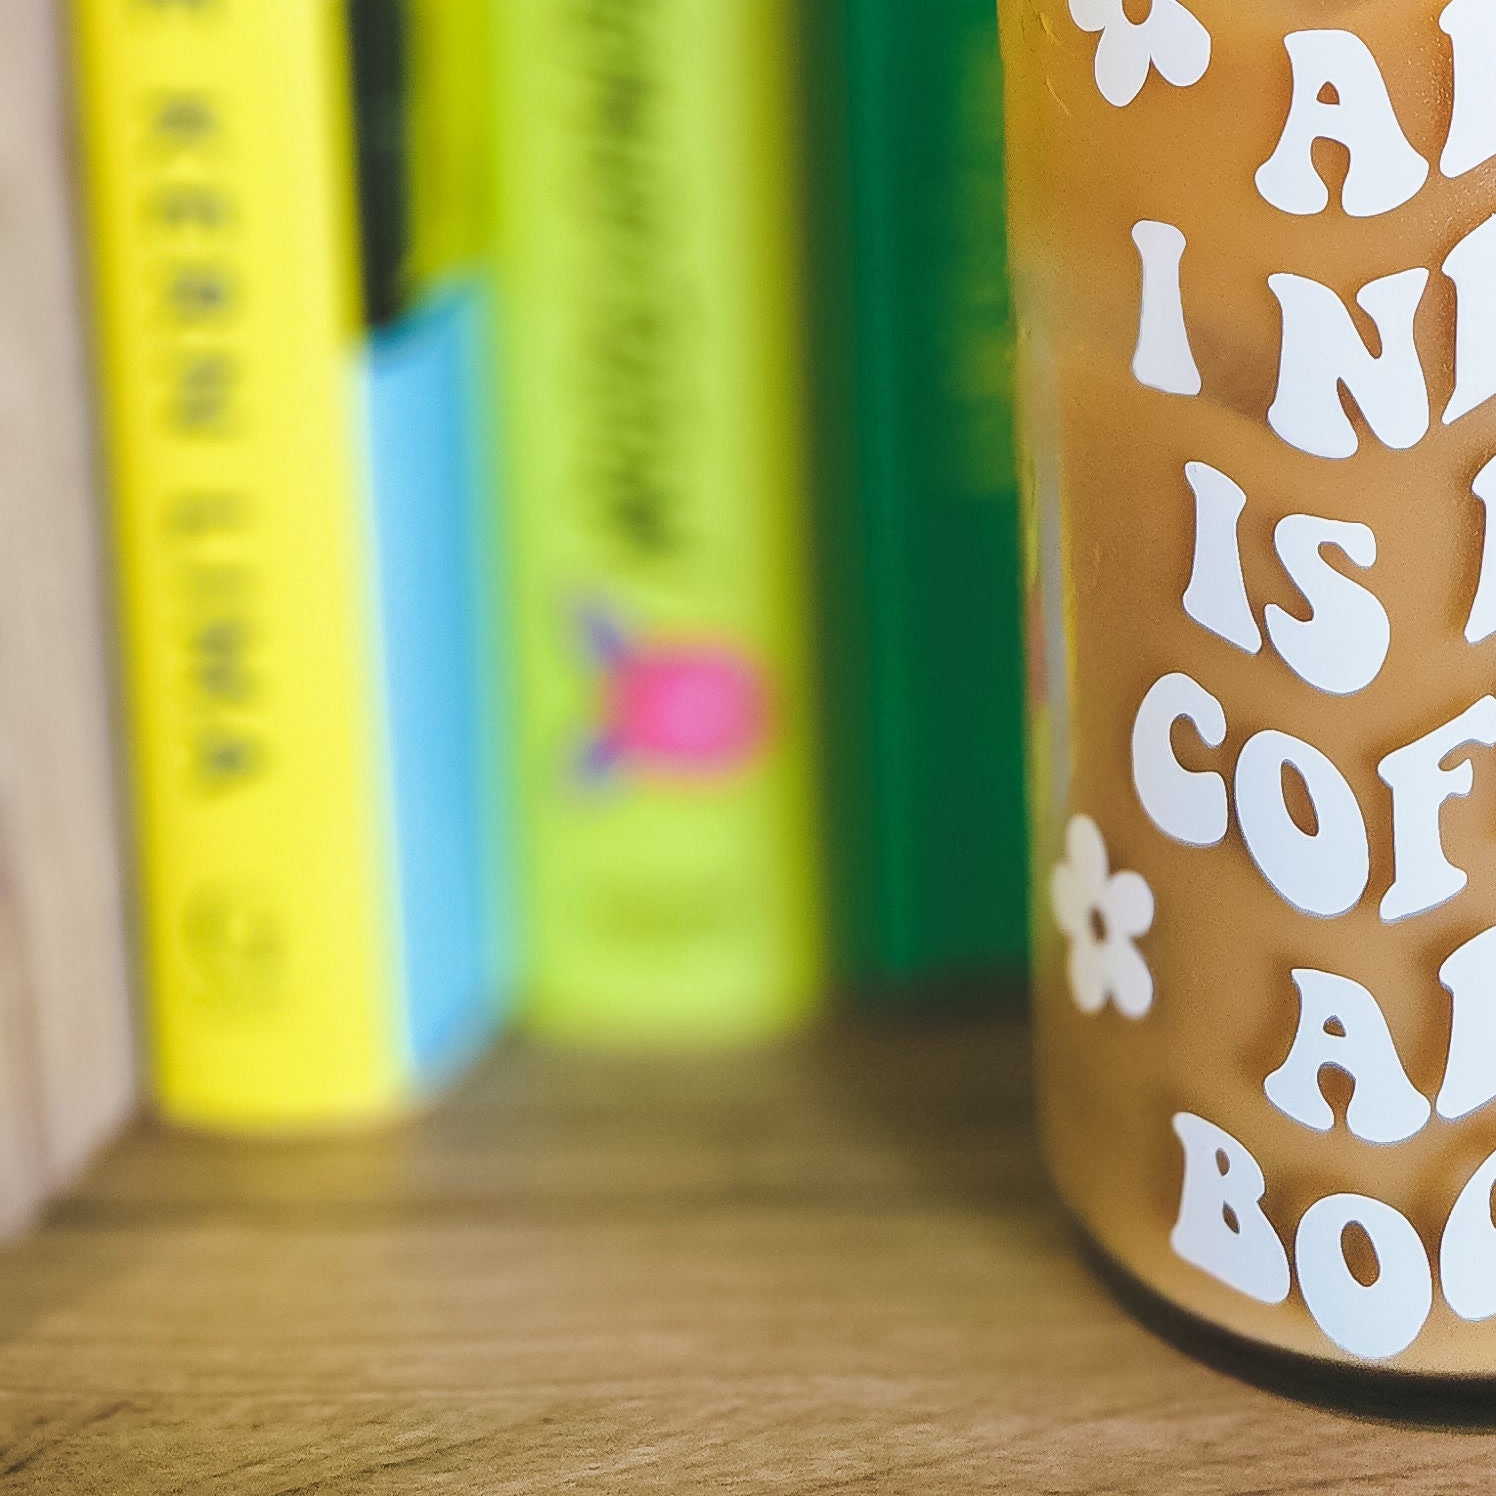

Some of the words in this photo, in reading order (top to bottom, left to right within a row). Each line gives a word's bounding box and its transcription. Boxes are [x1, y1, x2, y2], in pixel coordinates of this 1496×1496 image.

[137, 87, 244, 442] KERN
[1131, 219, 1202, 396] I
[156, 485, 274, 800] LIMA
[1182, 461, 1391, 695] IS
